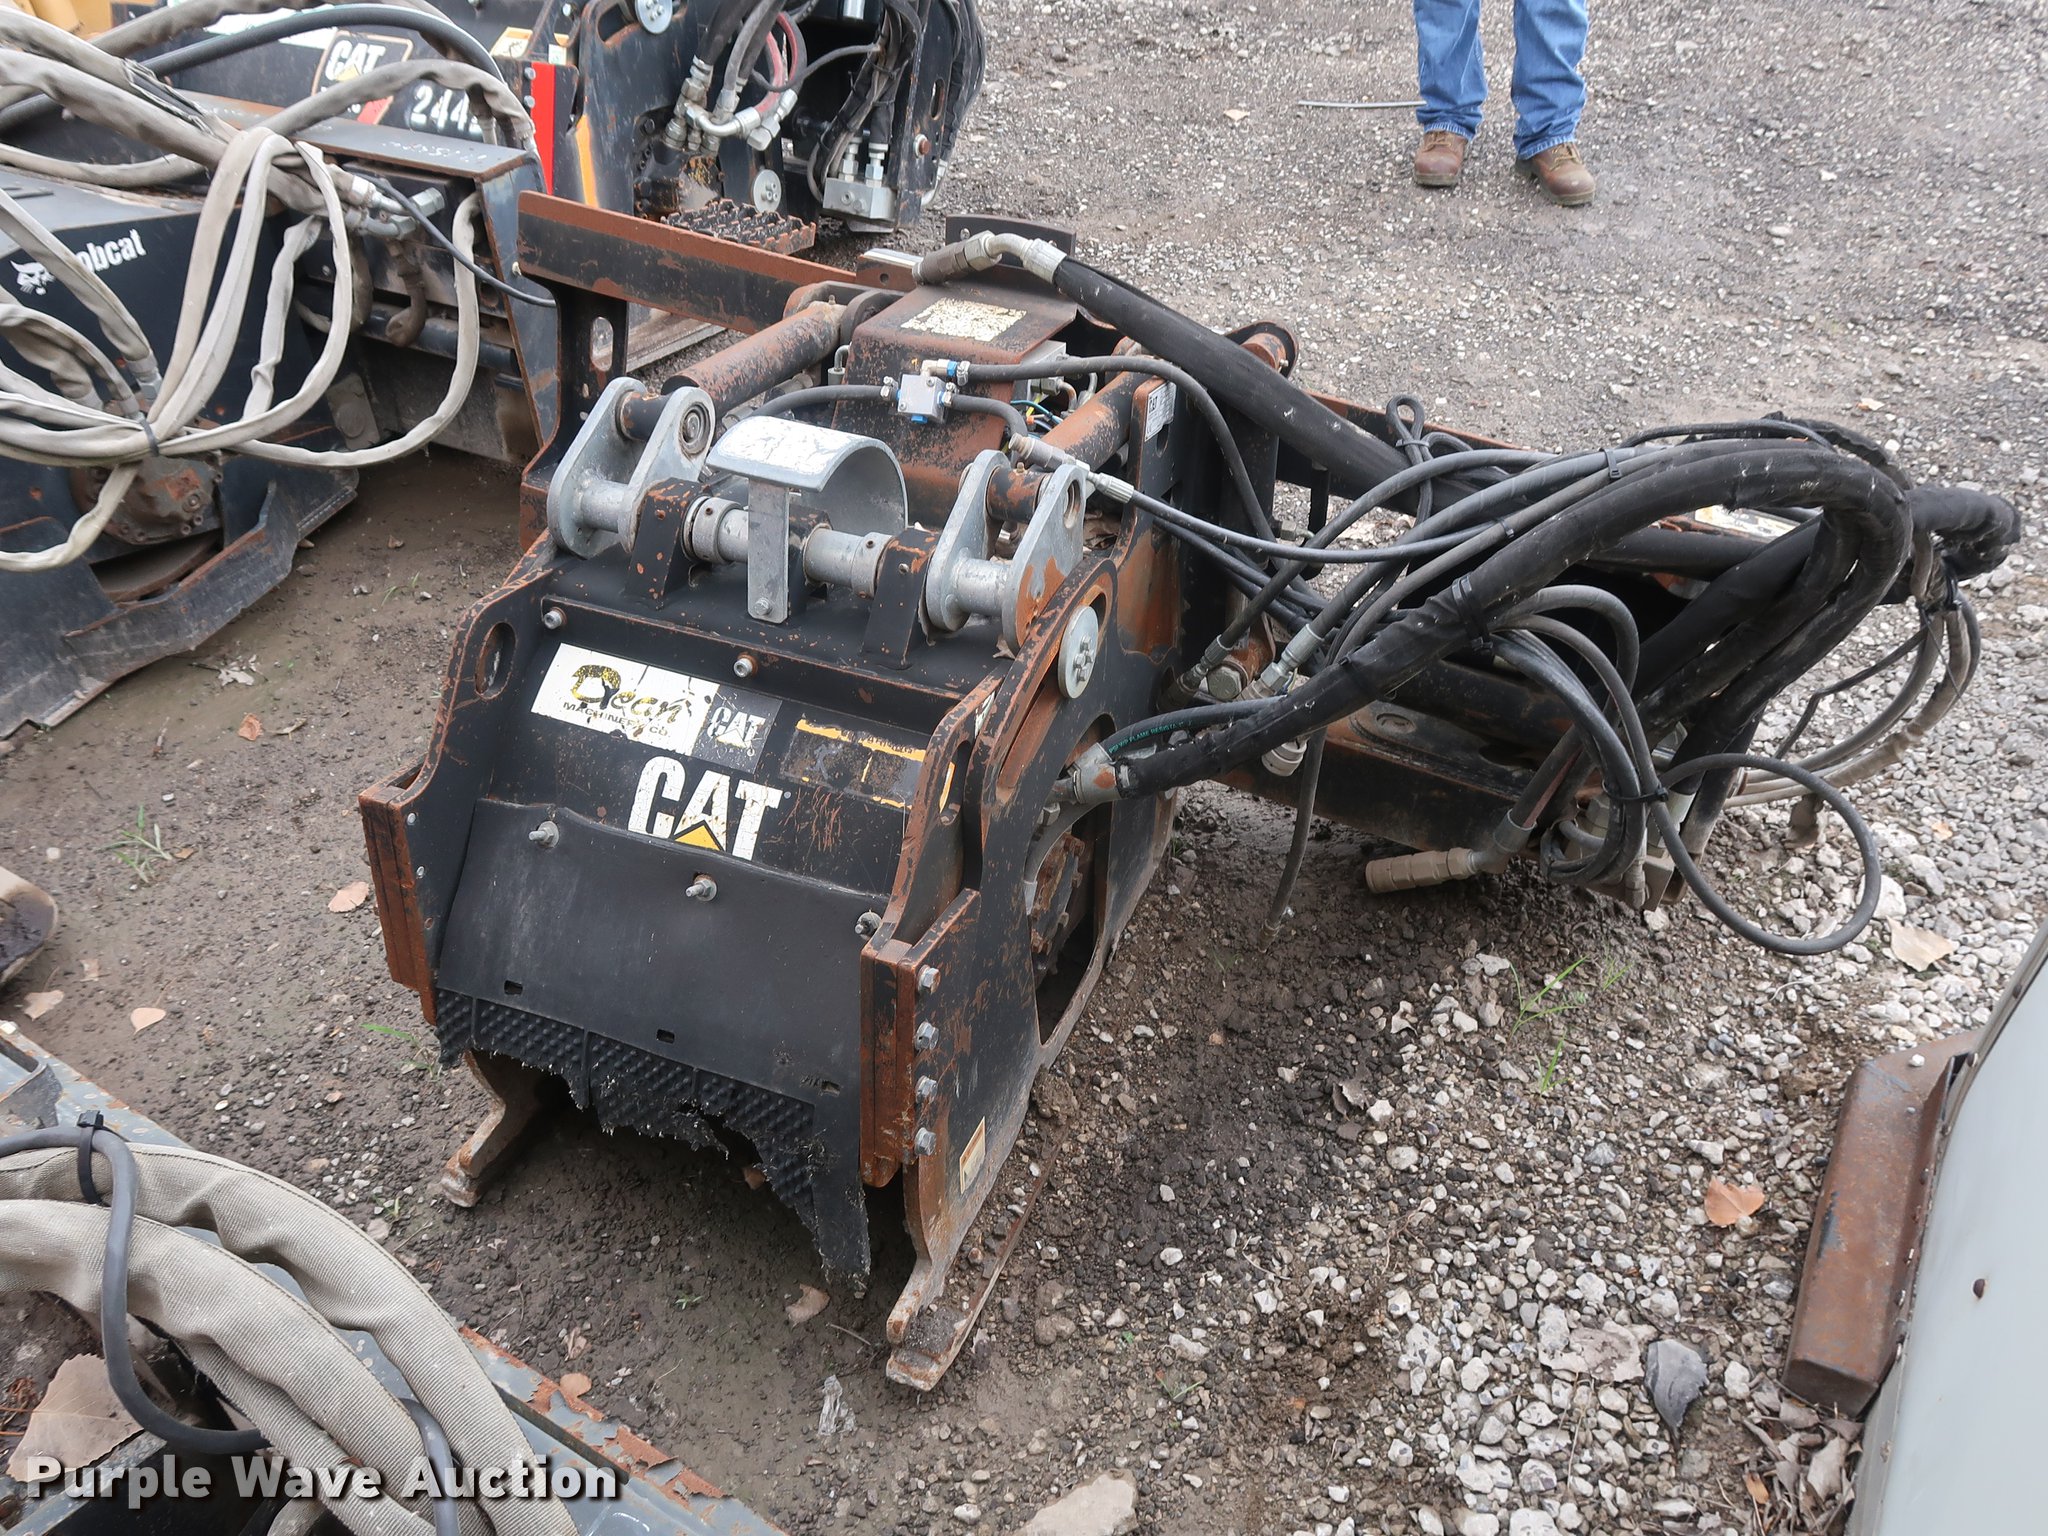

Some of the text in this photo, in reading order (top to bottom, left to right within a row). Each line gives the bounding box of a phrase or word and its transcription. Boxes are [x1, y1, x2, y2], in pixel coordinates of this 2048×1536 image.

[325, 40, 386, 82] CAT
[74, 228, 147, 273] obcat
[706, 706, 767, 748] CAT
[628, 756, 783, 861] CAT
